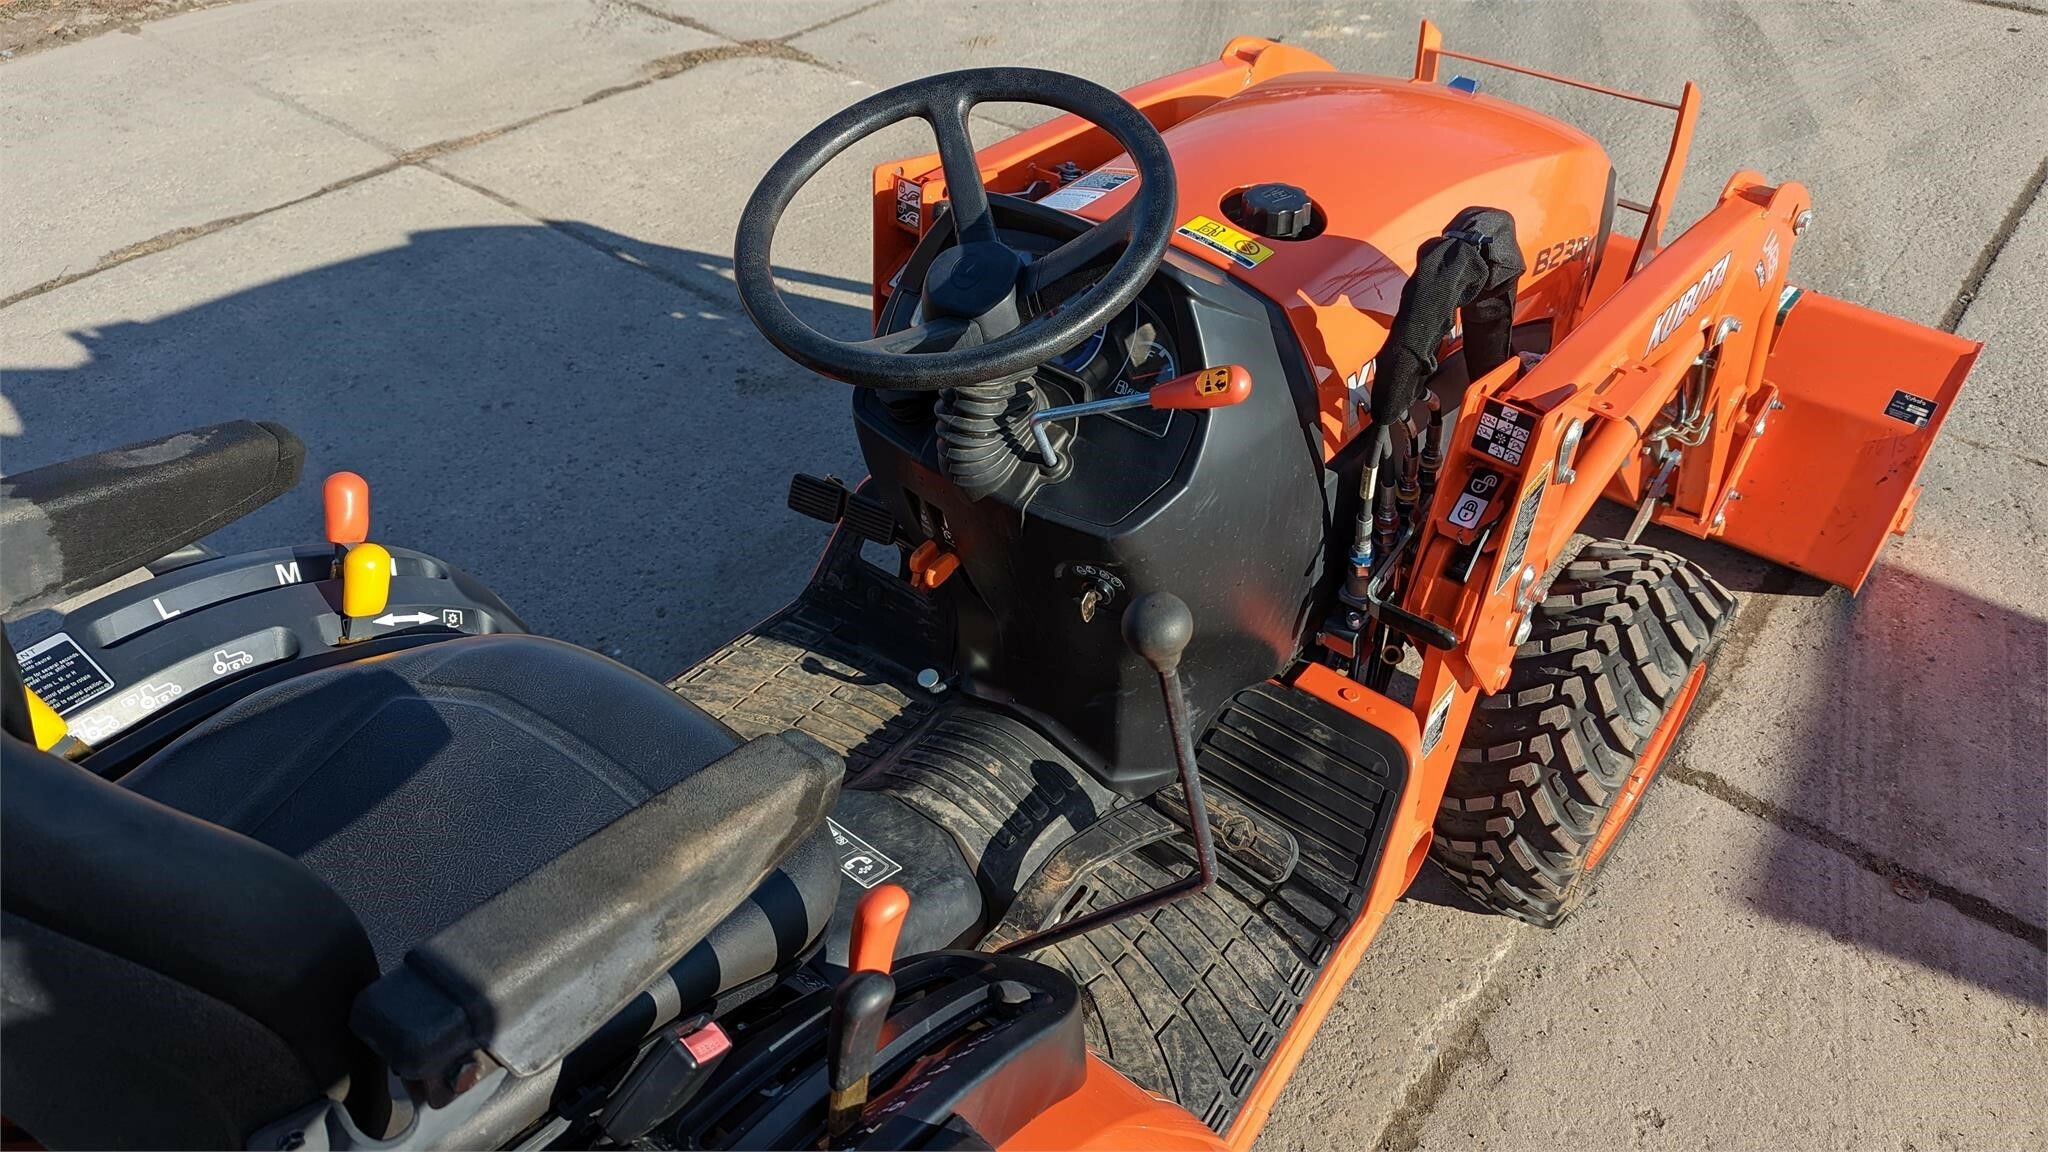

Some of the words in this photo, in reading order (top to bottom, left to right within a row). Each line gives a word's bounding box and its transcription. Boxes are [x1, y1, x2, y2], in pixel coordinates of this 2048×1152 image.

[1643, 251, 1732, 358] KUBOTA
[1347, 358, 1377, 427] K
[274, 561, 302, 585] M
[153, 598, 181, 620] L
